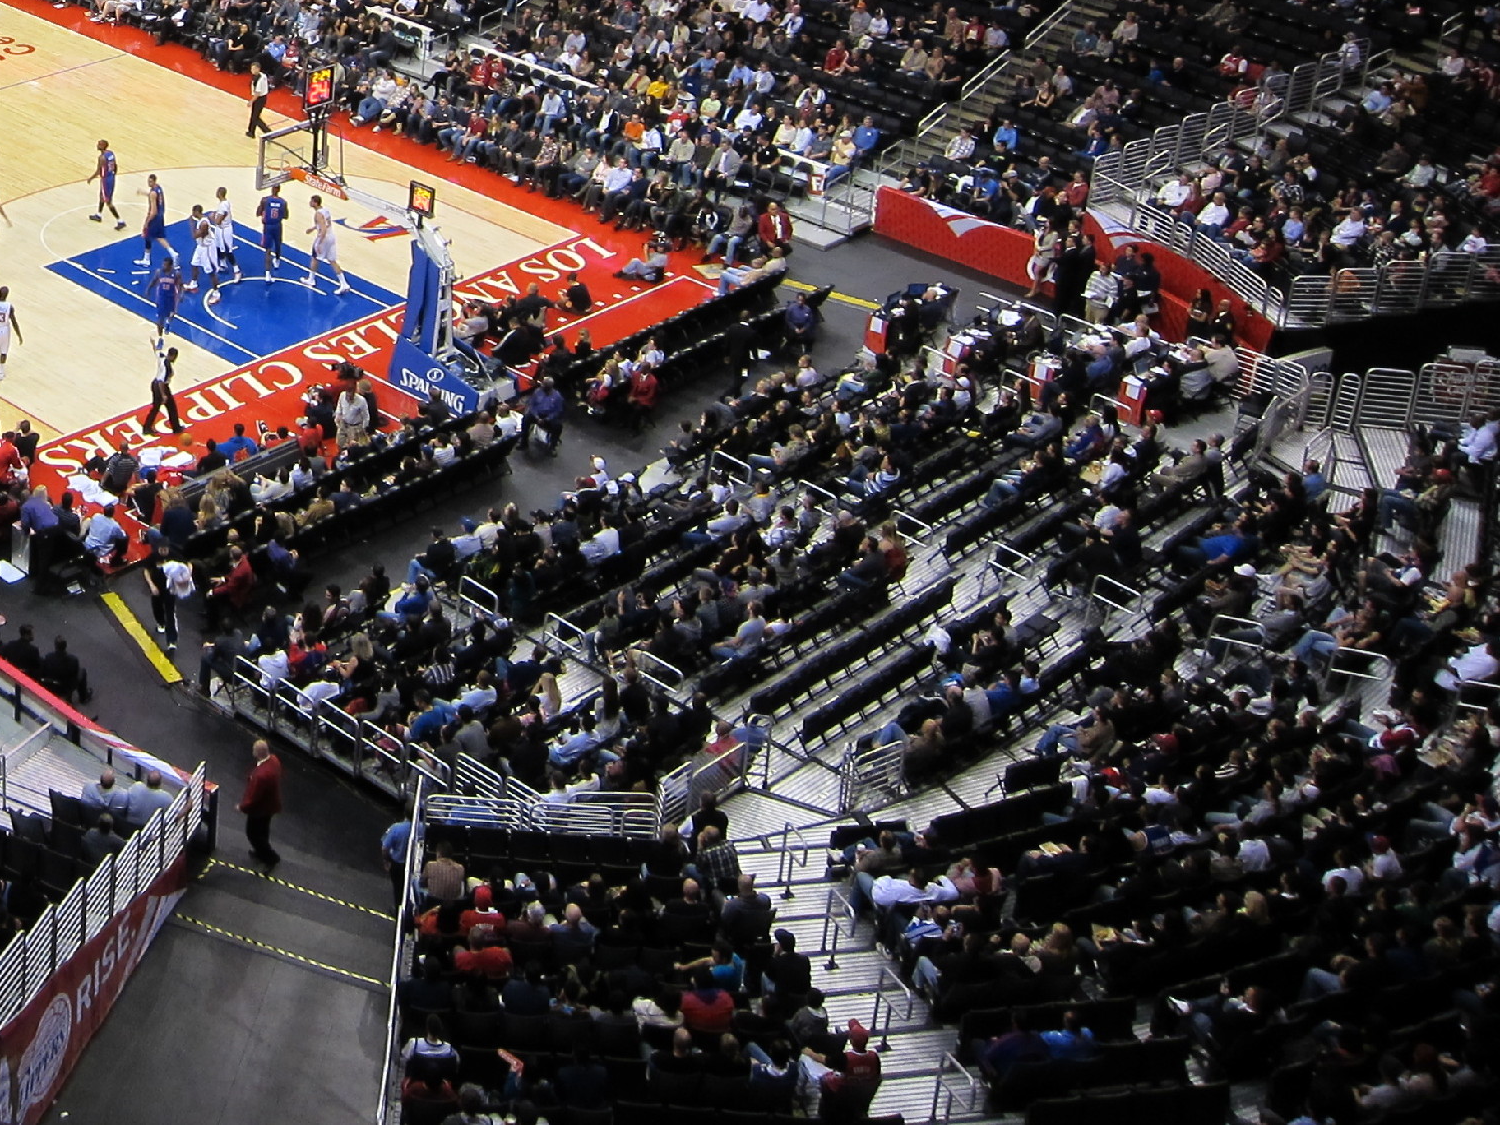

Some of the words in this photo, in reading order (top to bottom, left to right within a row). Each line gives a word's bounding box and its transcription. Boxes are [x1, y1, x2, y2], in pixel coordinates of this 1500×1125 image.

[307, 81, 330, 103] 24
[518, 237, 618, 283] LOS
[399, 367, 466, 415] SPALING
[76, 909, 137, 1025] RISE.
